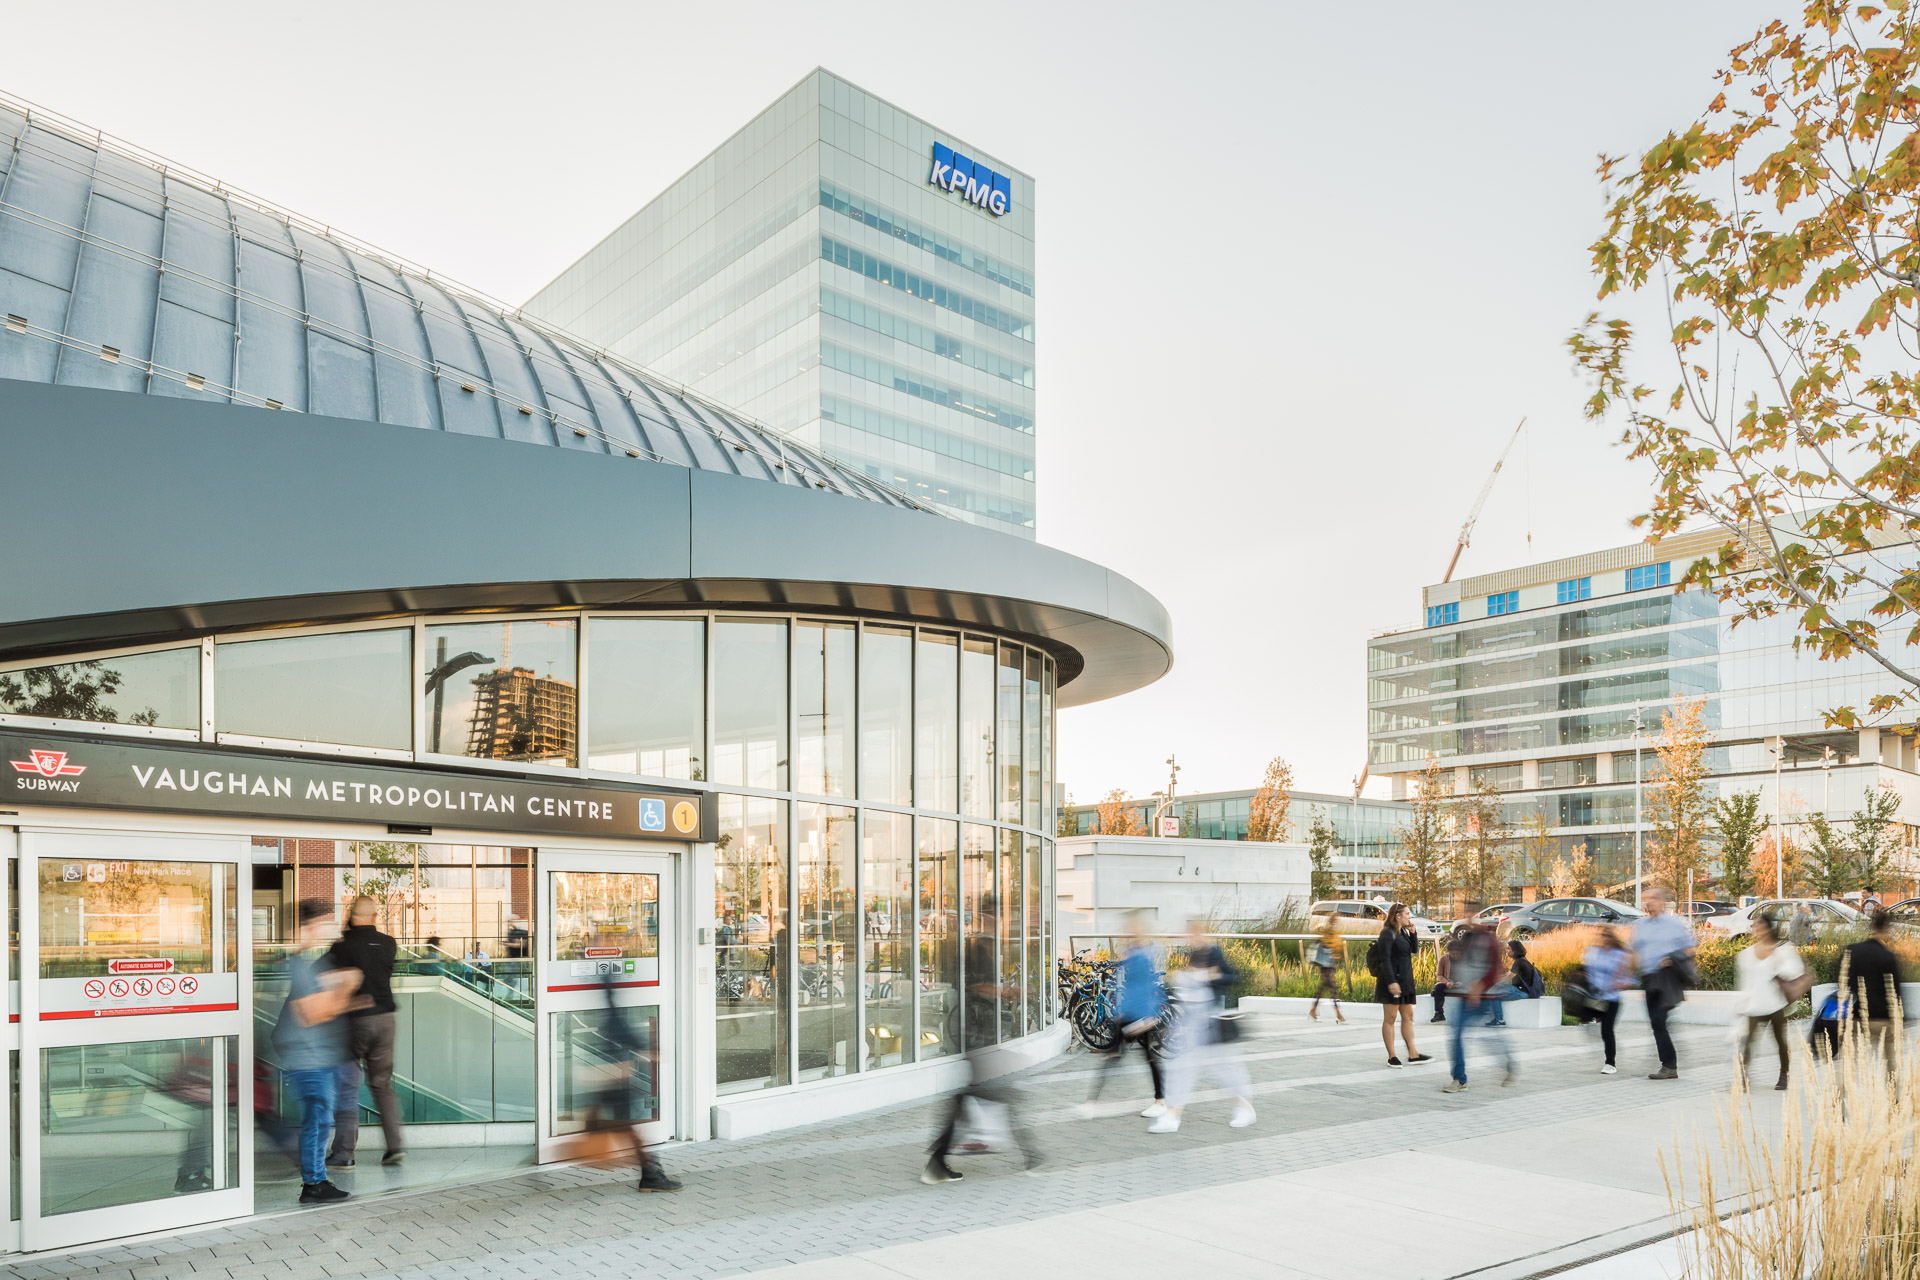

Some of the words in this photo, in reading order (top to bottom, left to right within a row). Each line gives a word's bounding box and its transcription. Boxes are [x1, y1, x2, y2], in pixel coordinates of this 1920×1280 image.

[930, 159, 1007, 216] KPMG
[17, 777, 80, 792] SUBWAY
[132, 765, 292, 798] VAUGHAN
[305, 779, 515, 813] METROPOLITAN
[527, 797, 613, 820] CENTRE
[682, 809, 688, 825] 1
[109, 862, 128, 873] EXIT
[133, 867, 150, 876] New
[152, 867, 169, 876] Park
[170, 868, 192, 876] Place
